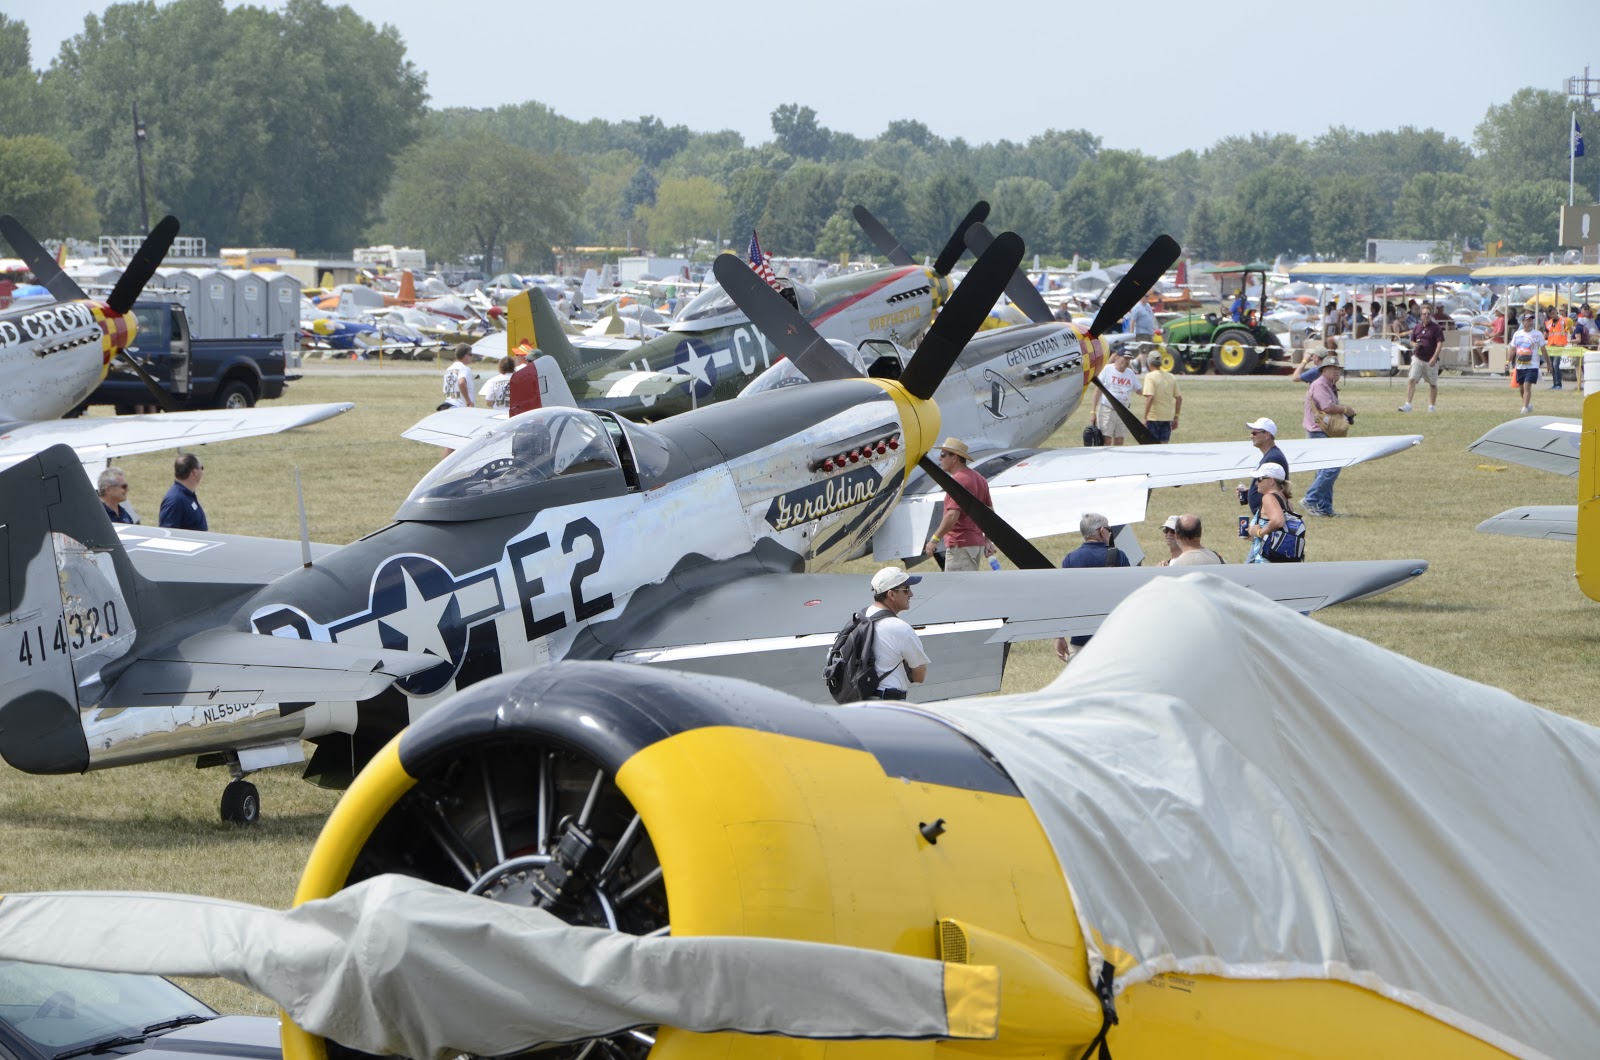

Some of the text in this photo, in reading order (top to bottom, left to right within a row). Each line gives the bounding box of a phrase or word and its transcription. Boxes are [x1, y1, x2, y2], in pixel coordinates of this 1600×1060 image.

[22, 303, 93, 340] CROW
[733, 323, 770, 375] CY
[1006, 331, 1078, 367] GENTLEMAN JIM
[1112, 375, 1131, 386] TWA
[775, 476, 877, 530] Geraldine
[507, 516, 615, 642] E2
[19, 600, 119, 666] 414320
